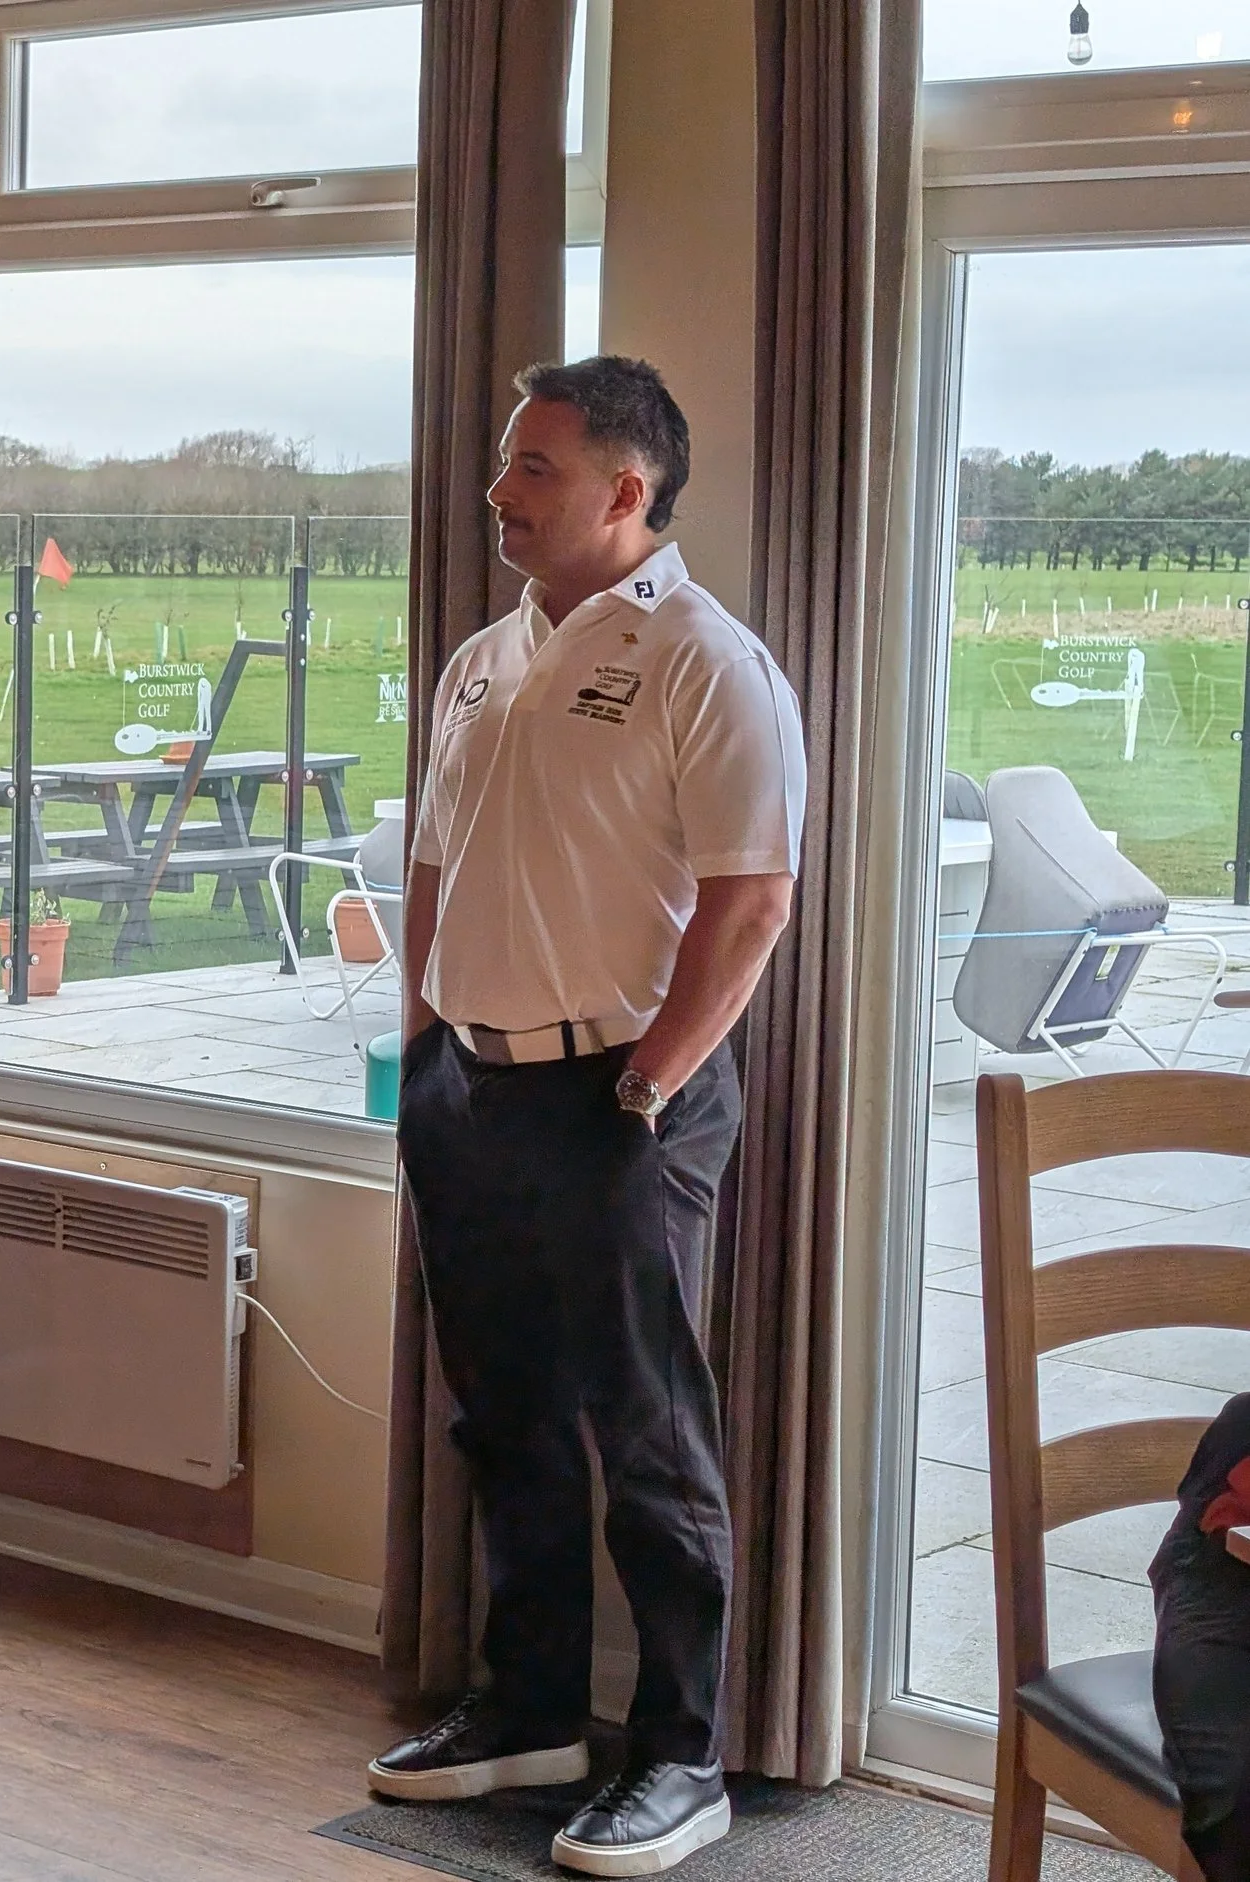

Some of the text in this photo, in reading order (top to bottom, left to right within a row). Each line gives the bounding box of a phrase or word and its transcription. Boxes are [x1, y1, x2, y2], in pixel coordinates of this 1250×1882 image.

[633, 580, 656, 599] FJ
[1060, 634, 1137, 648] BURSTWICK
[1059, 650, 1125, 663] COUNTRY
[139, 663, 205, 678] BURSTWICK
[1058, 665, 1095, 678] GOLF
[138, 682, 195, 698] COUNTRY
[138, 703, 170, 718] GOLF
